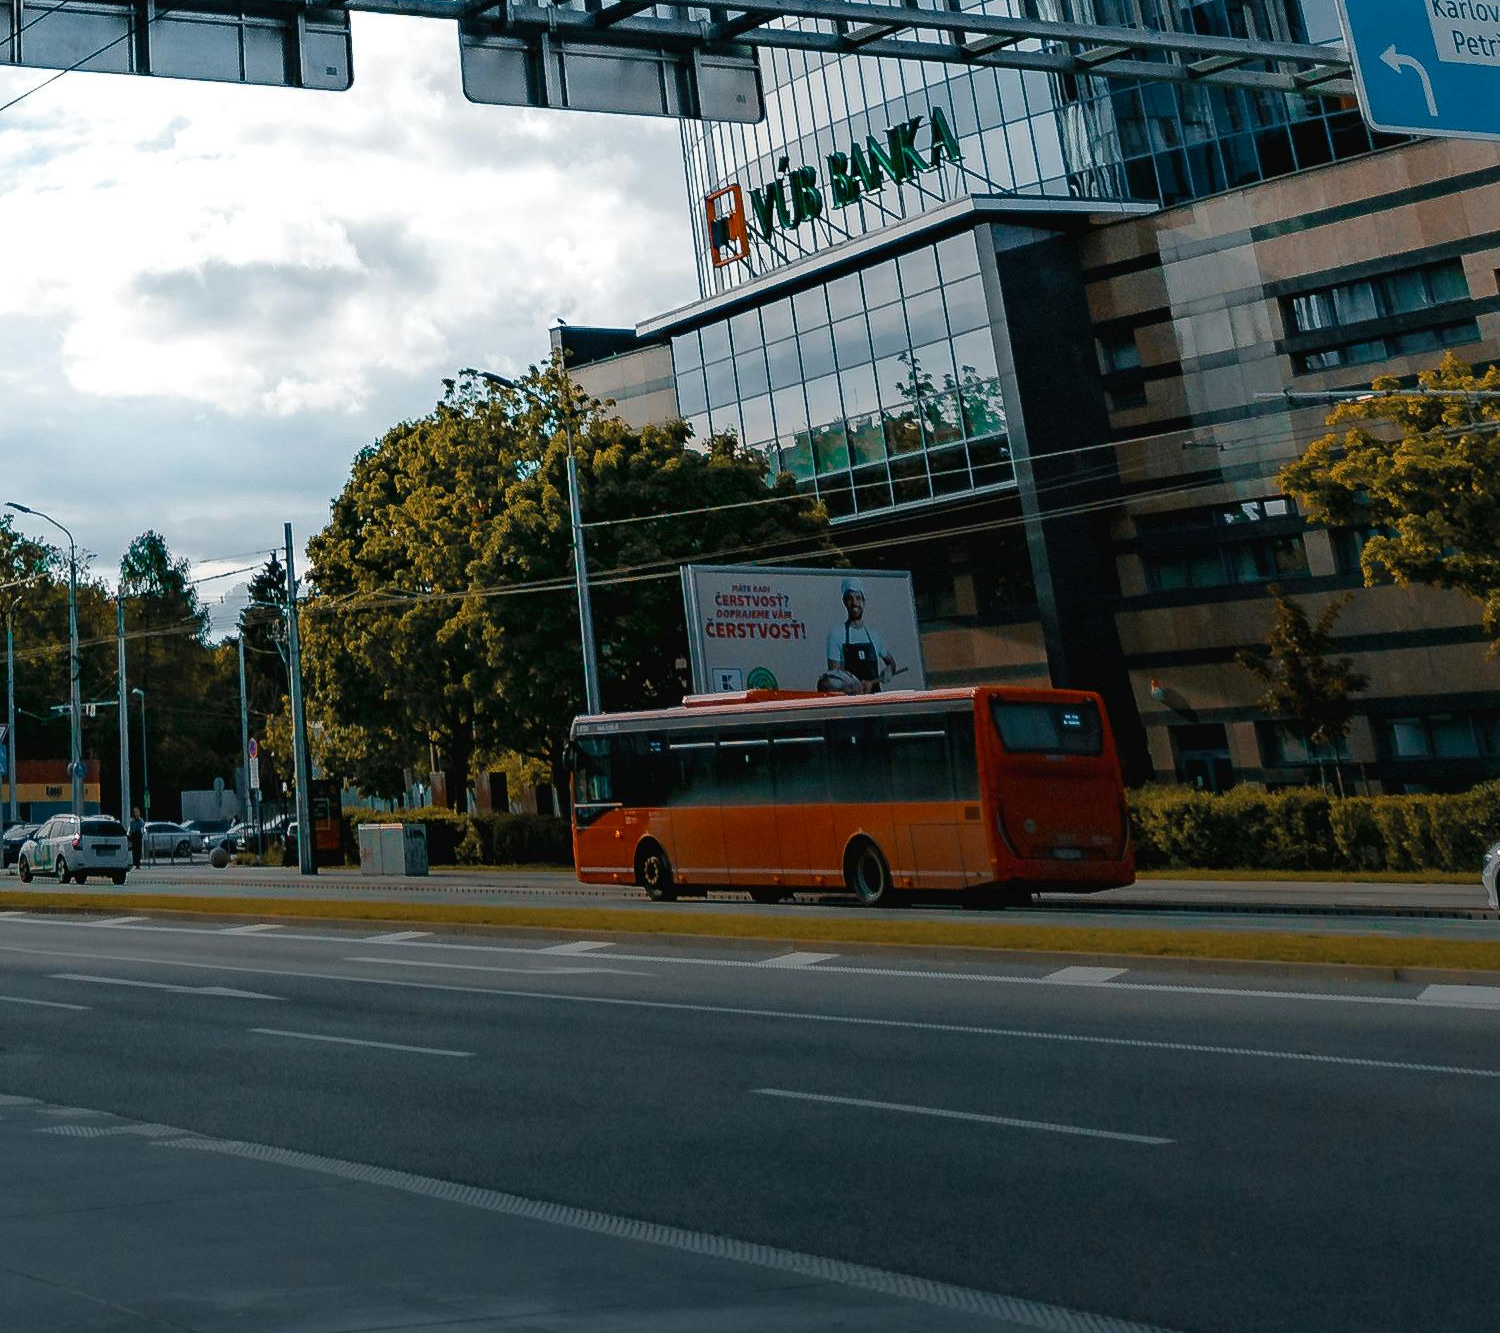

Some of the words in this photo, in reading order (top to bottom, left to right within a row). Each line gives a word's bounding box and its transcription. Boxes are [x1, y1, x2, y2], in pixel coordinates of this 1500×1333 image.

[747, 156, 823, 242] VÚB
[825, 105, 965, 211] BANKA
[714, 591, 790, 608] ČERSTVOSŤ?
[705, 617, 807, 640] ČERSTVOSŤ!
